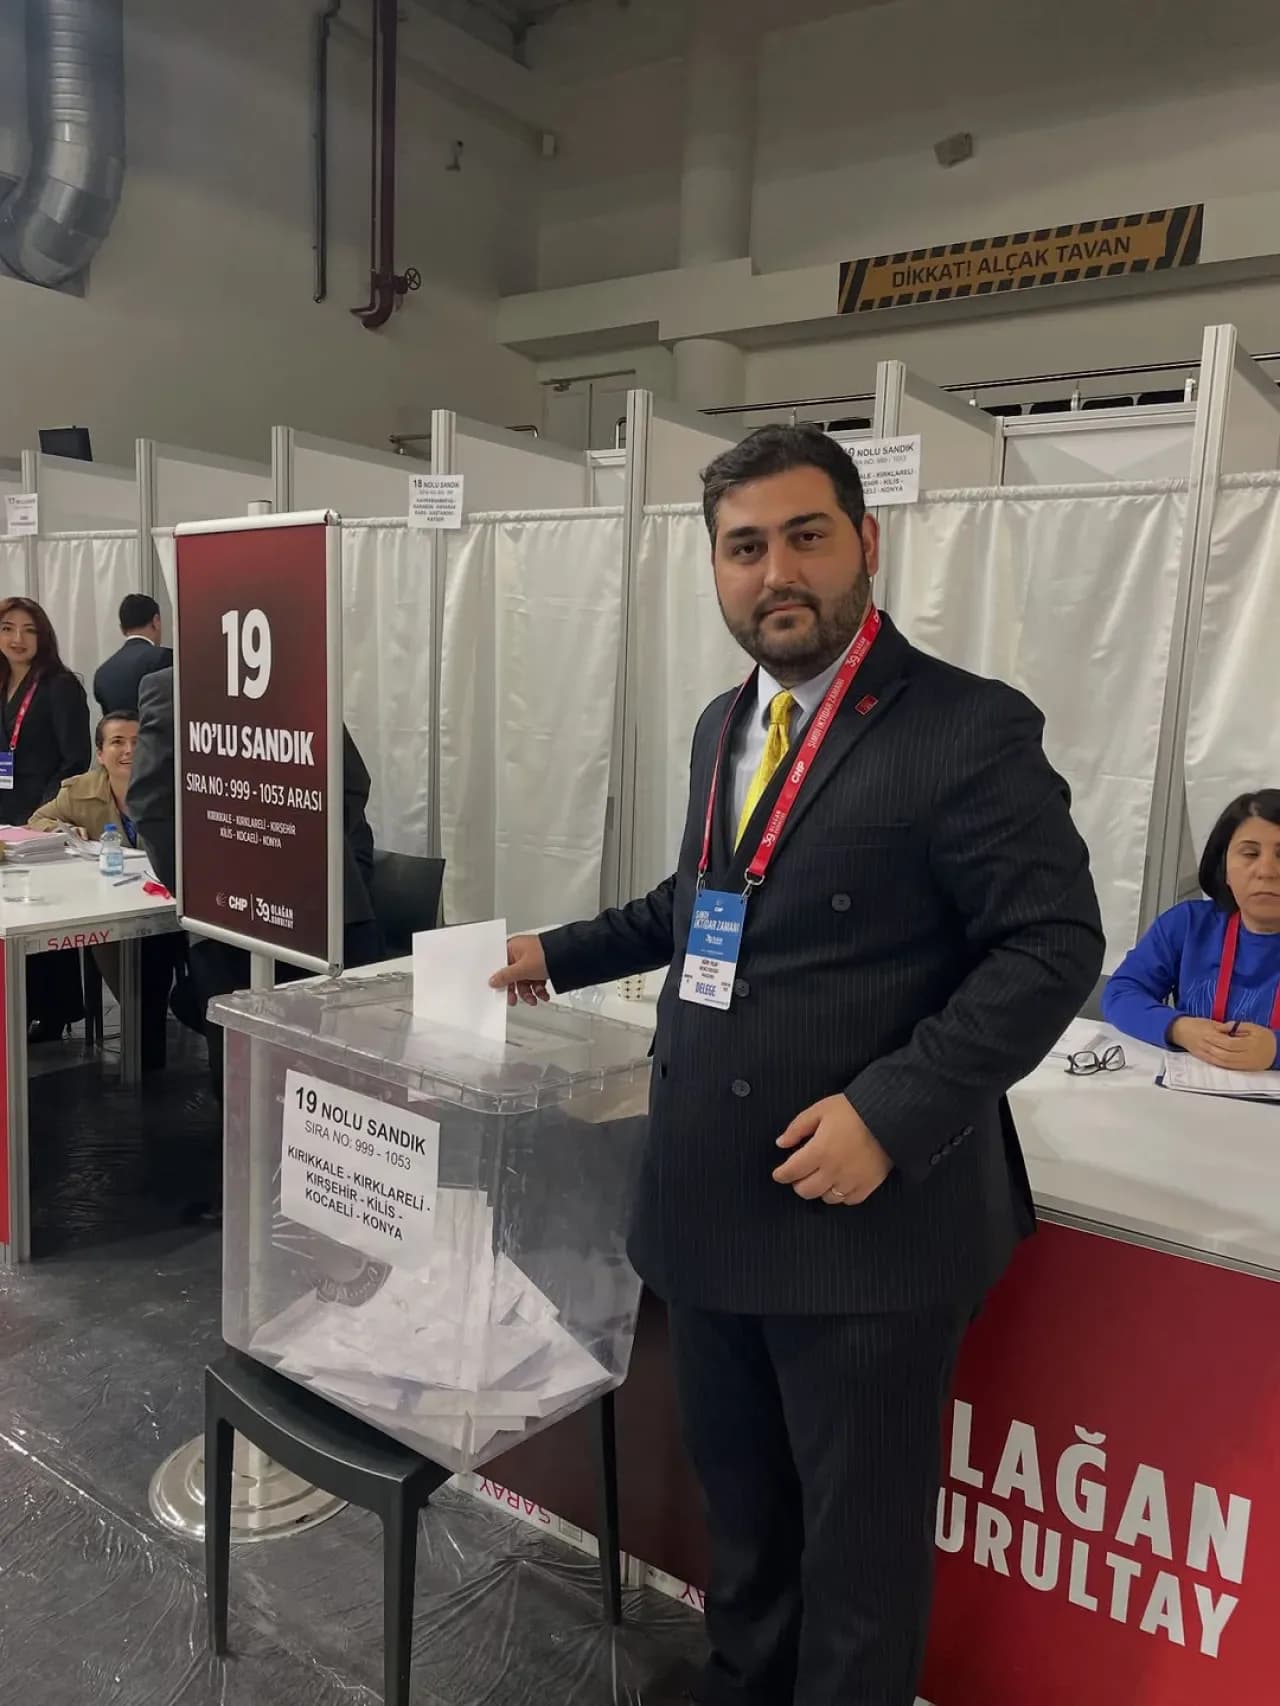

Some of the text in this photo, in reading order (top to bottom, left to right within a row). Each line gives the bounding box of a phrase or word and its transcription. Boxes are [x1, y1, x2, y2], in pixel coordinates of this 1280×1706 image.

[892, 236, 1131, 289] DİKKAT! ALÇAK TAVAN
[222, 608, 272, 700] 19
[189, 721, 316, 766] NO'LU SANDIK
[186, 772, 207, 793] SIRA
[209, 776, 224, 797] NO
[230, 779, 251, 801] 999
[259, 783, 285, 807] 1053
[287, 788, 323, 812] ARASI
[791, 760, 805, 784] CHP
[228, 895, 248, 912] CHP
[47, 929, 111, 951] SARAY
[695, 981, 717, 998] DELEGE
[295, 1086, 426, 1156] 19 NOLU SANDIK
[304, 1120, 330, 1140] SIRA
[333, 1130, 352, 1148] NO:
[355, 1139, 374, 1157] 999
[385, 1150, 411, 1171] 1053
[287, 1145, 344, 1179] KIRIKKALE
[354, 1172, 424, 1211] KIRKLARELİ
[306, 1171, 358, 1201] KIRŞEHİR
[367, 1195, 396, 1219] KİLİS
[305, 1188, 353, 1218] KOCAELİ
[363, 1212, 403, 1241] KONYA
[950, 1398, 1252, 1585] LAĞAN
[934, 1486, 1240, 1659] URULTAY
